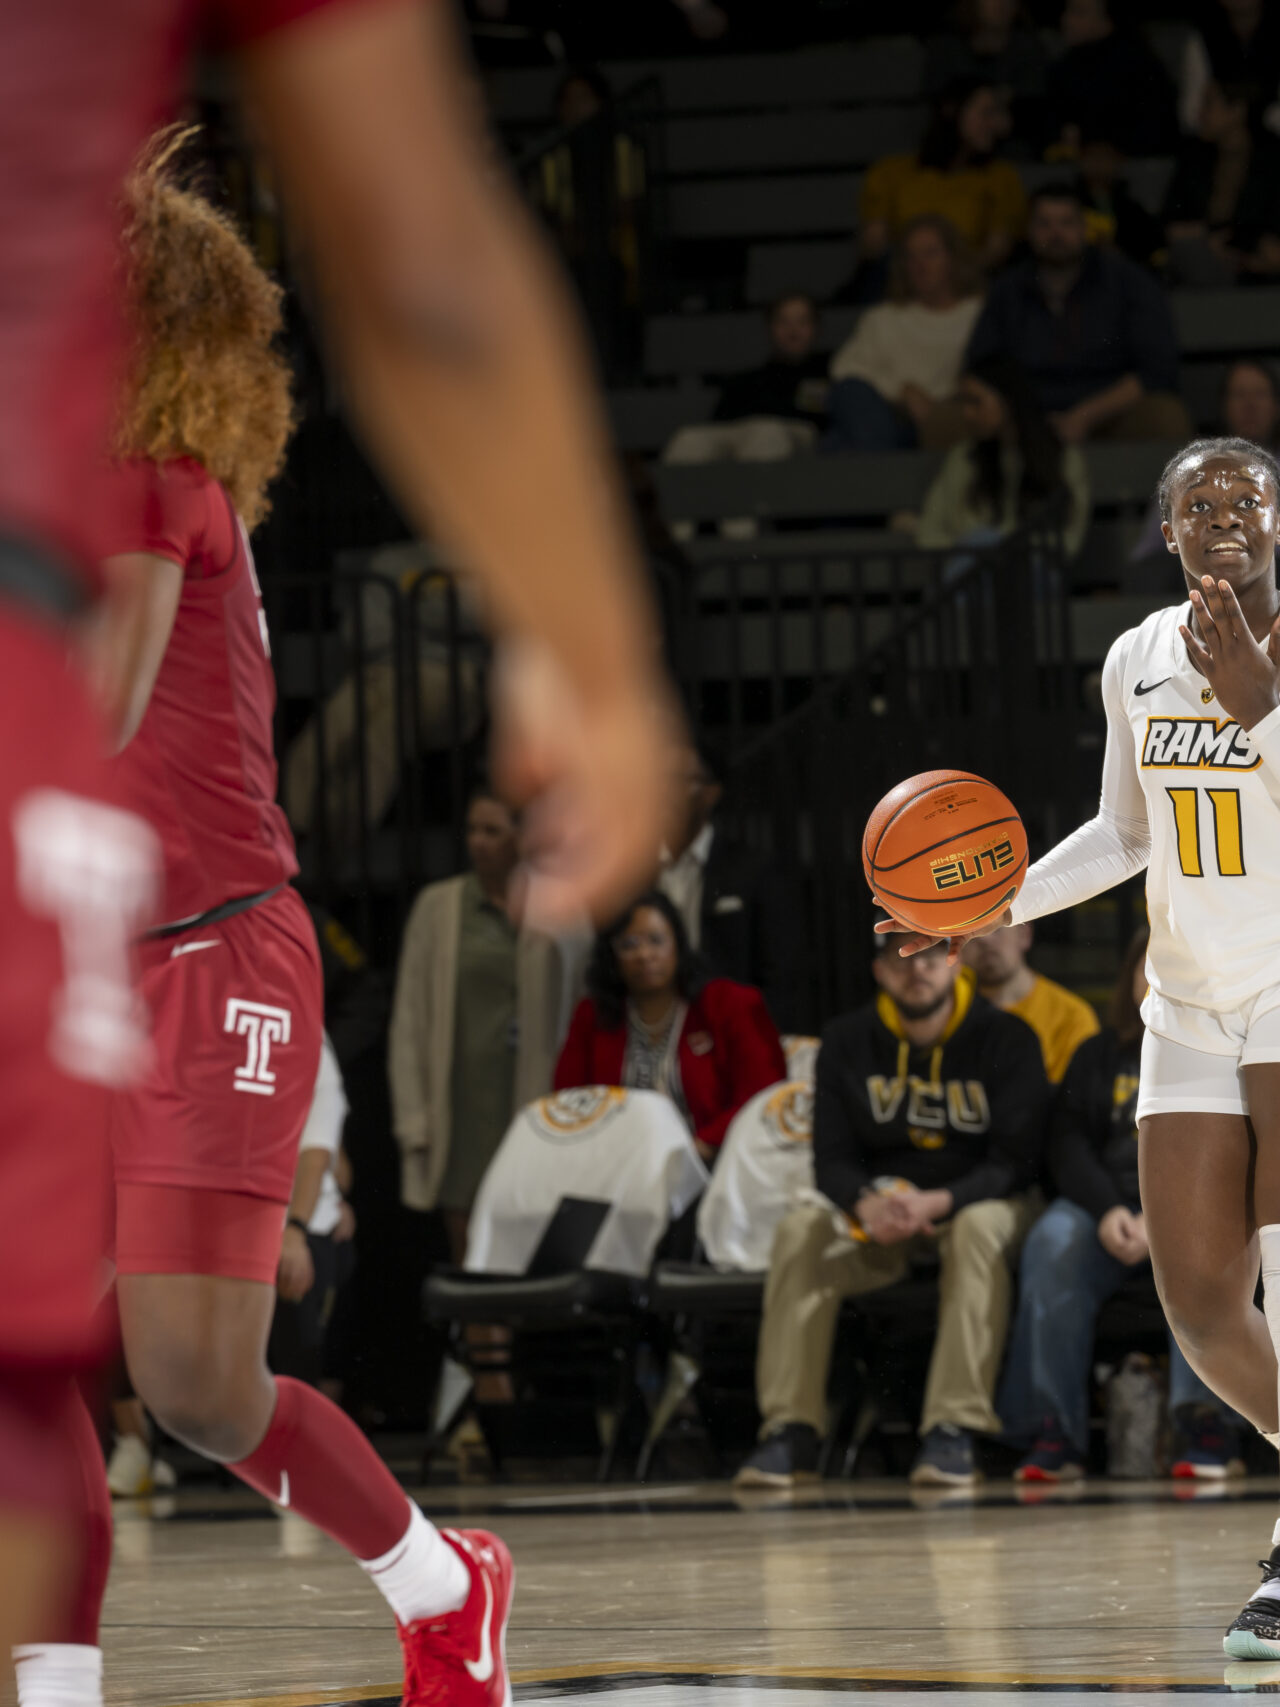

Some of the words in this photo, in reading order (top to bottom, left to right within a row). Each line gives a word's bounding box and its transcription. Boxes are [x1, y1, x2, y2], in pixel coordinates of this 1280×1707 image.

[1141, 716, 1264, 772] RAMS
[930, 832, 1009, 867] CHAMPIONSHIP
[1165, 787, 1247, 878] 11
[932, 839, 1015, 891] ELITE
[866, 1074, 991, 1134] VCU
